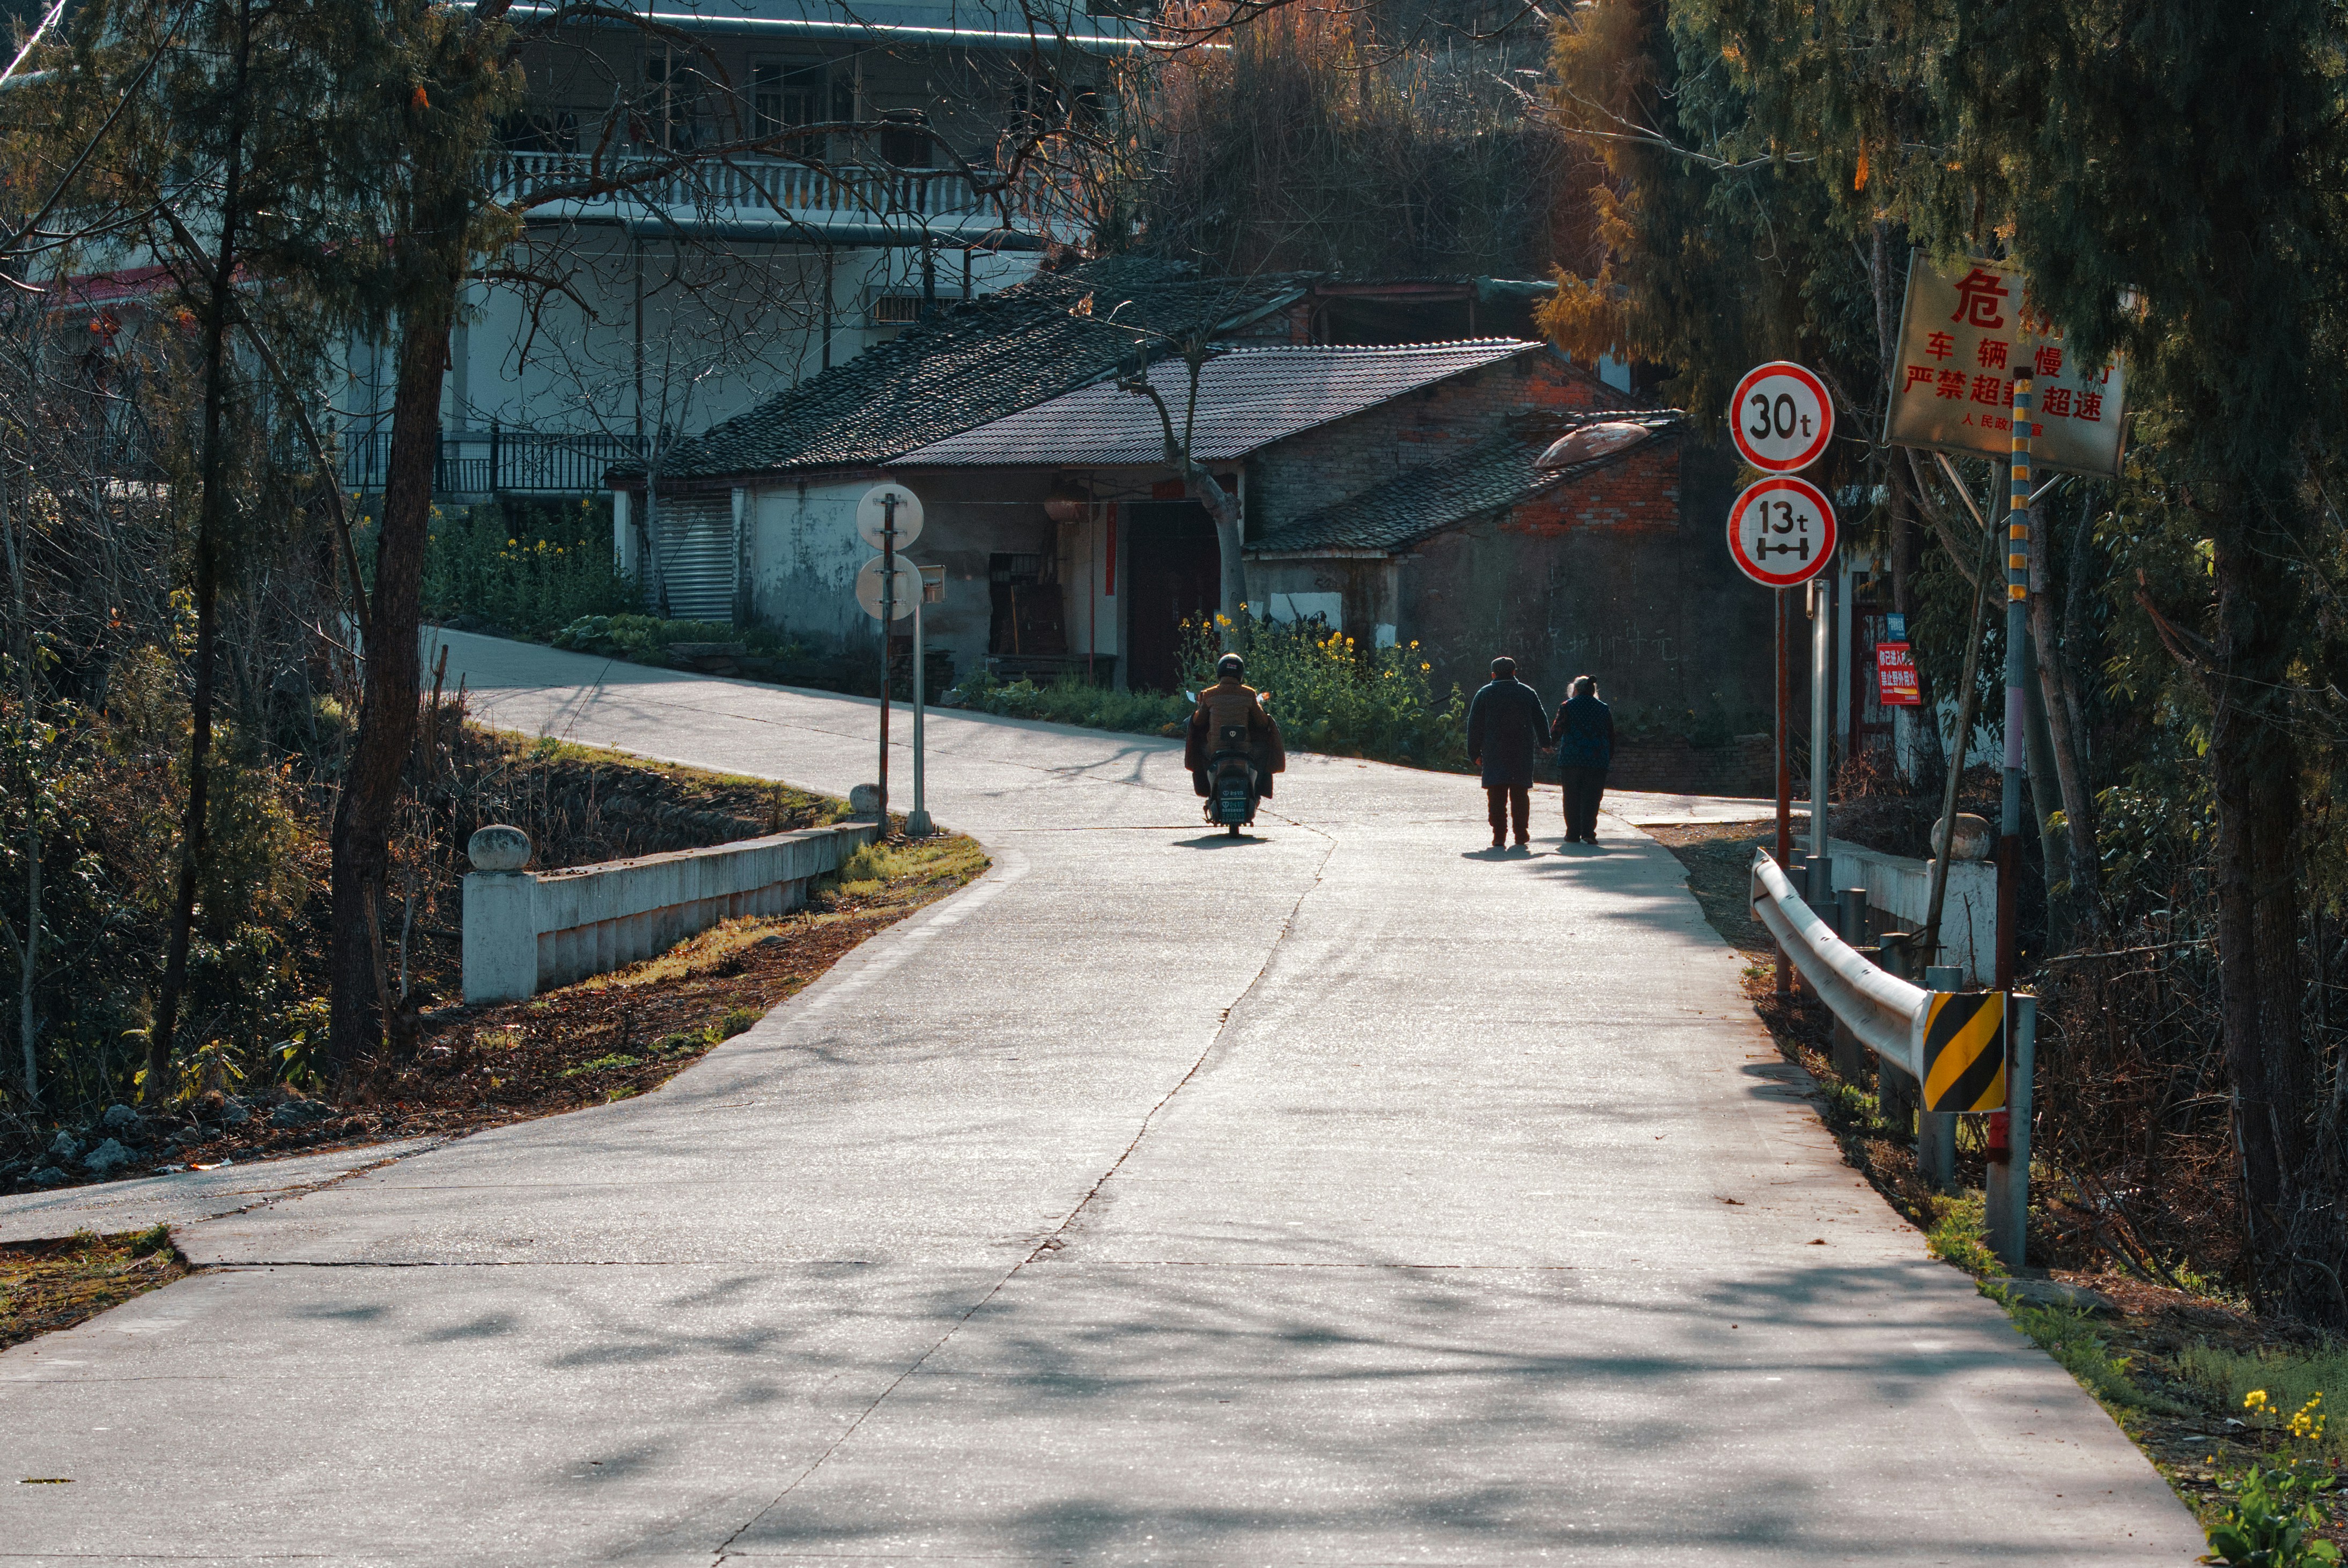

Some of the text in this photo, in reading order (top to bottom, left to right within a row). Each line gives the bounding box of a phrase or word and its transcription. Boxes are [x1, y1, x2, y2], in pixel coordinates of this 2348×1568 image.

[1950, 268, 2063, 339] 危
[1749, 393, 1811, 439] 30t
[1961, 412, 2044, 437] 人民政宣
[1759, 501, 1808, 534] 13t
[1881, 671, 1915, 686] 禁止野外用火
